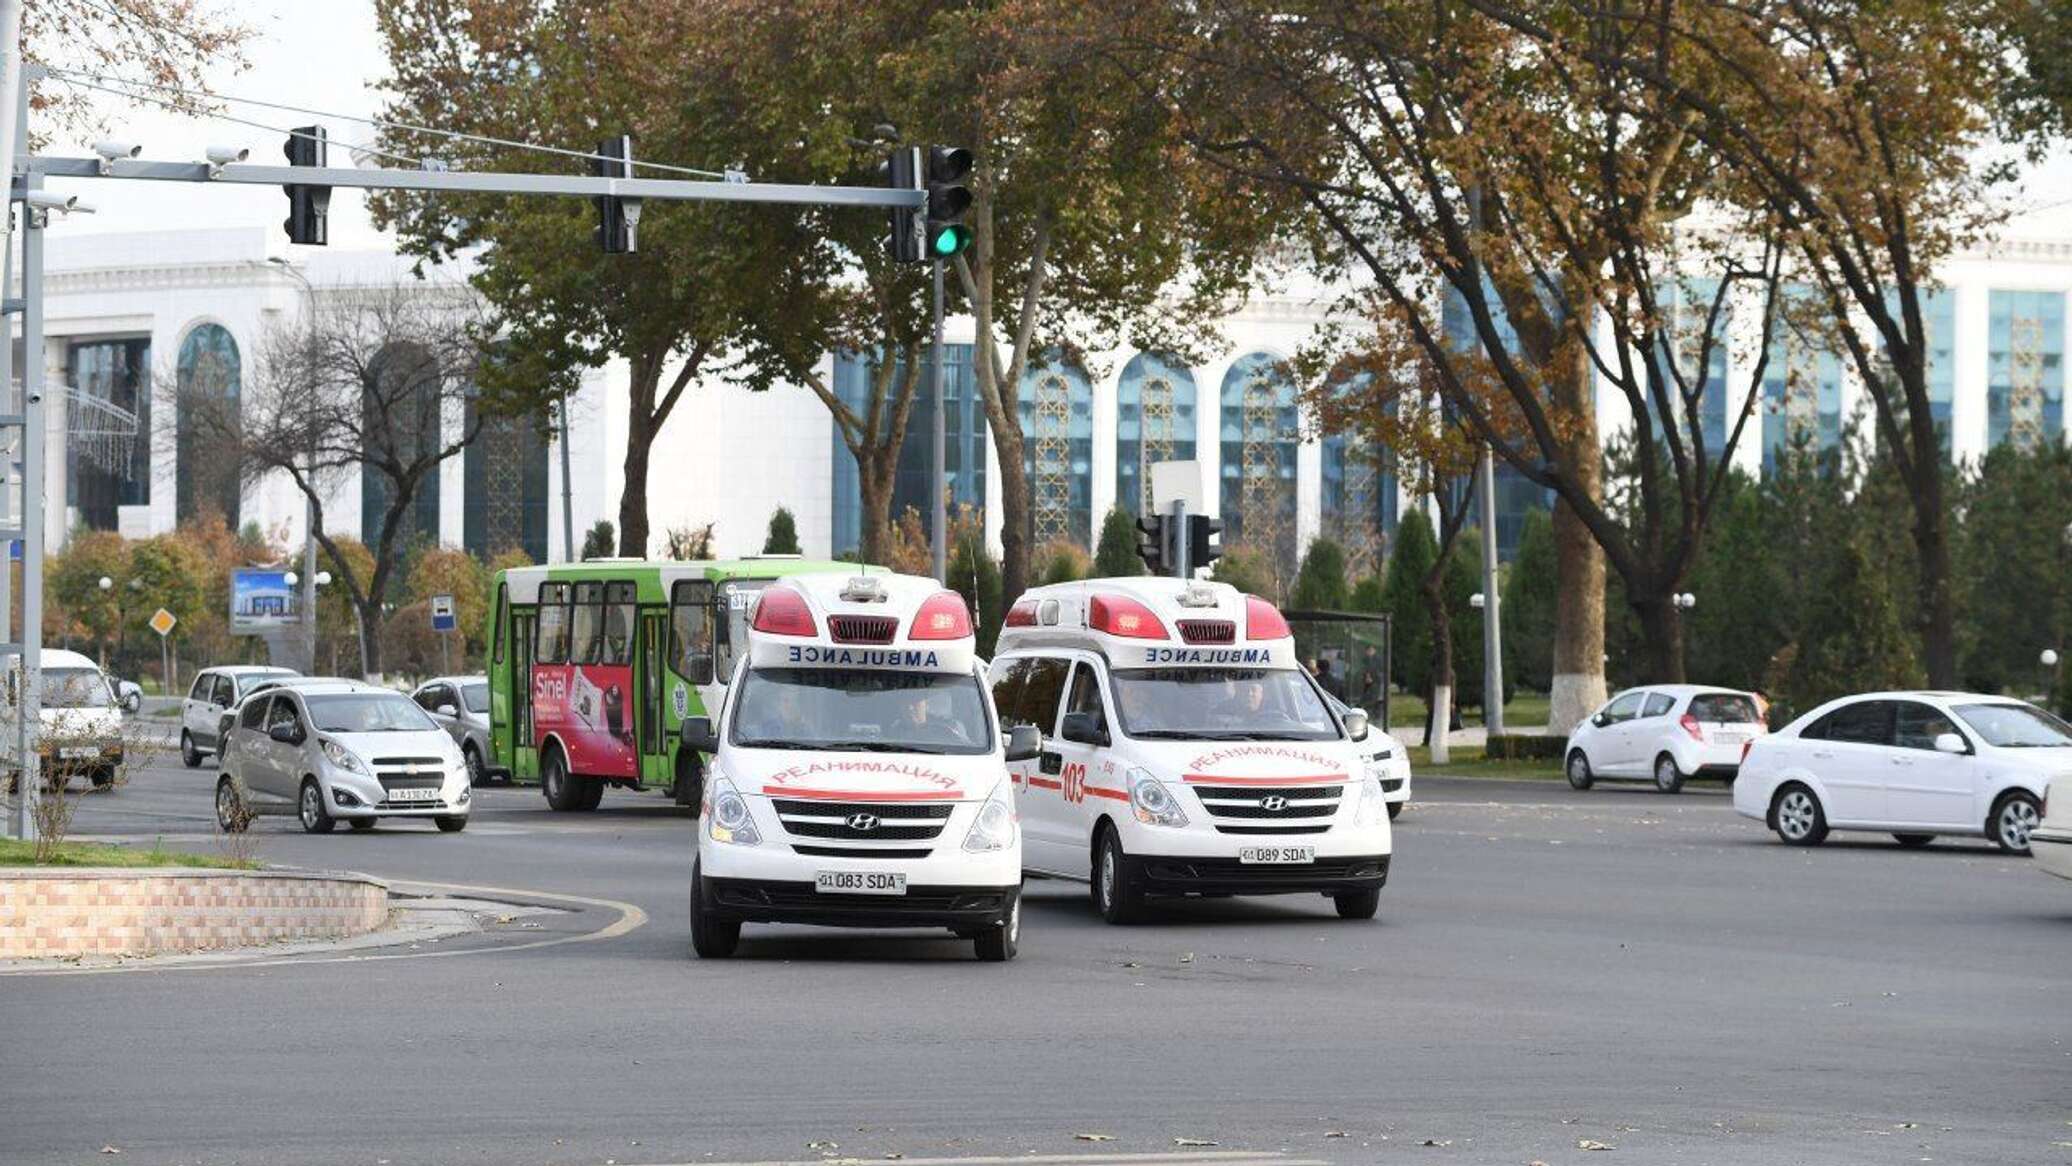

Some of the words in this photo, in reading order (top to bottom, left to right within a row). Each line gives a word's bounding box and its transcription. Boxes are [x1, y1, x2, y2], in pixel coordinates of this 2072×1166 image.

[772, 761, 957, 789] РЕАНИМАЦИЯ
[1061, 763, 1086, 804] 103
[1257, 848, 1279, 861] 089
[1283, 848, 1307, 861] SDA
[836, 873, 863, 888] 083
[867, 874, 896, 889] SDA
